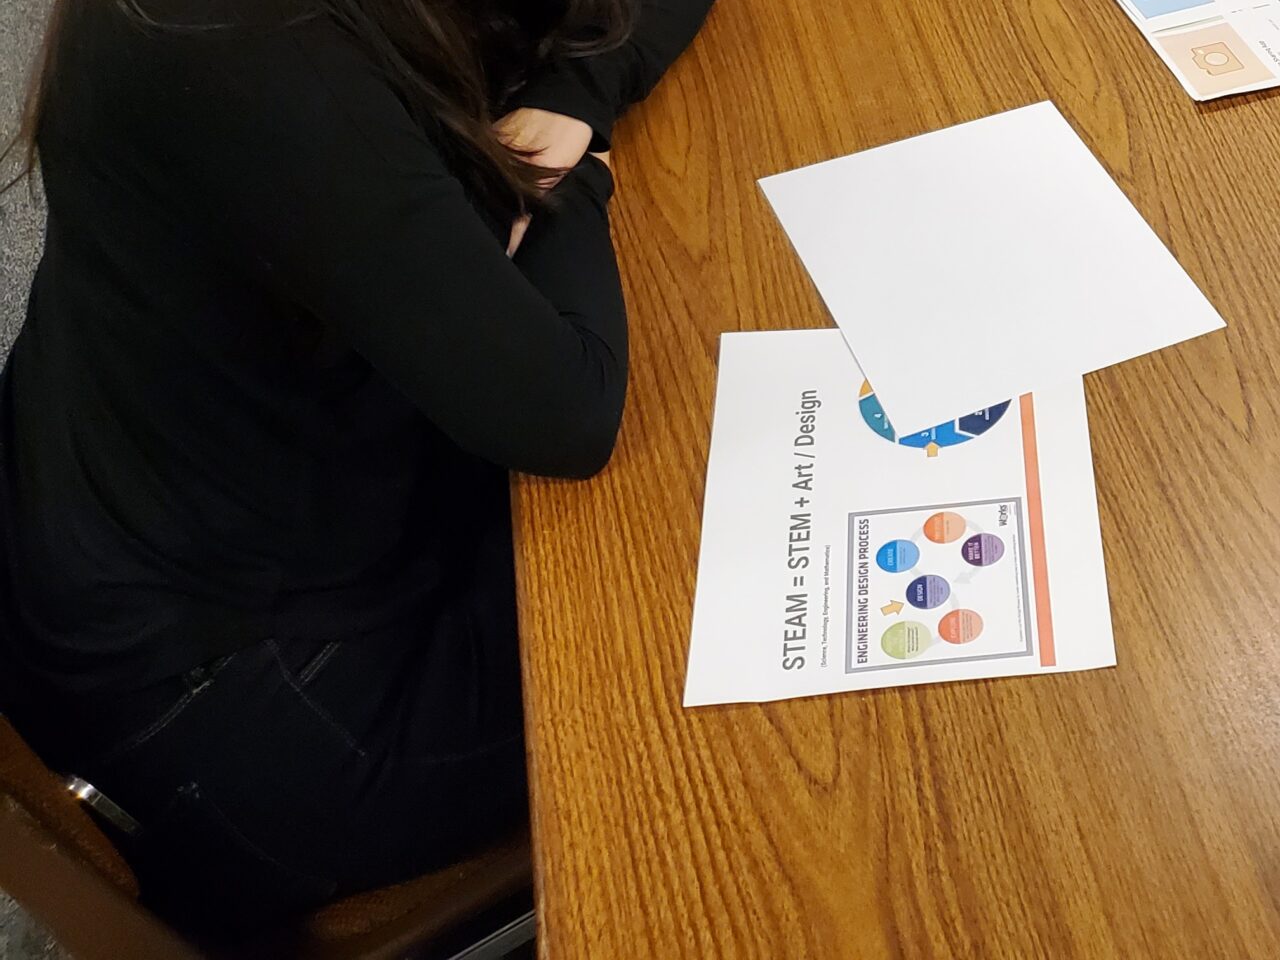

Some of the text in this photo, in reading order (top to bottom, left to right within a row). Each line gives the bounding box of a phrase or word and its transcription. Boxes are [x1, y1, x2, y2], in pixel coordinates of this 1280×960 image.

[794, 389, 823, 447] Design
[791, 463, 815, 492] Art
[794, 495, 810, 508] +
[787, 512, 812, 570] STEM
[823, 544, 831, 576] Mathematics)
[793, 575, 807, 587] =
[857, 518, 870, 664] ENGINEERING DESIGN PROCESS
[915, 584, 924, 602] DESIGN
[822, 586, 830, 616] Engineering,
[781, 592, 810, 671] STEAM
[821, 616, 829, 645] Technology,
[820, 645, 828, 668] (Science,
